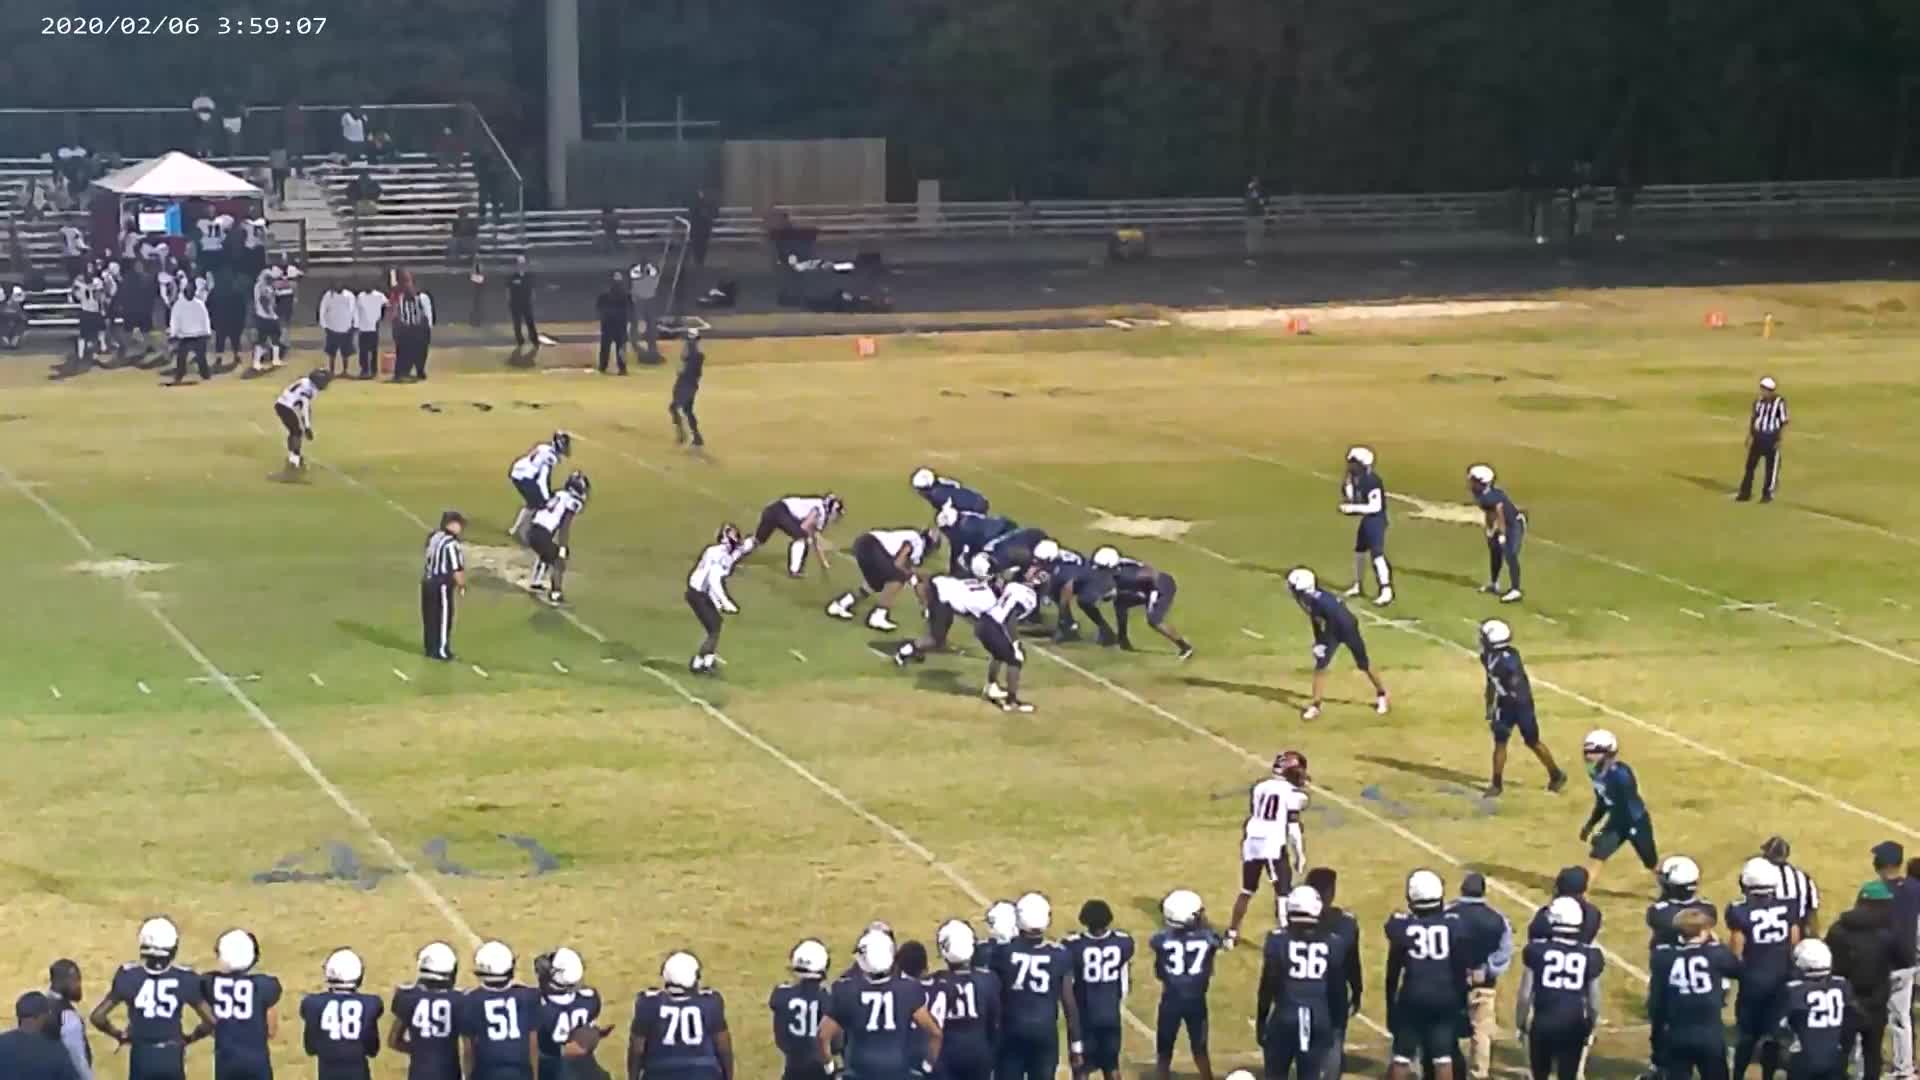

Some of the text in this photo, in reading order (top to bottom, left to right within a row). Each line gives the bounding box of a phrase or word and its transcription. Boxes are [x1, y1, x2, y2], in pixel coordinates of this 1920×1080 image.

[1406, 925, 1449, 959] 30
[1750, 906, 1788, 943] 25
[1011, 952, 1051, 993] 75
[1083, 946, 1121, 982] 82
[1163, 941, 1209, 975] 37
[1288, 942, 1328, 979] 56
[1542, 950, 1587, 990] 29
[1669, 956, 1712, 994] 46
[134, 978, 179, 1018] 45
[213, 977, 253, 1019] 59
[411, 997, 452, 1037] 49
[788, 998, 819, 1036] 31
[861, 991, 896, 1031] 71
[1807, 988, 1844, 1028] 20
[320, 1000, 363, 1040] 48
[484, 998, 520, 1040] 51
[659, 1005, 703, 1045] 70
